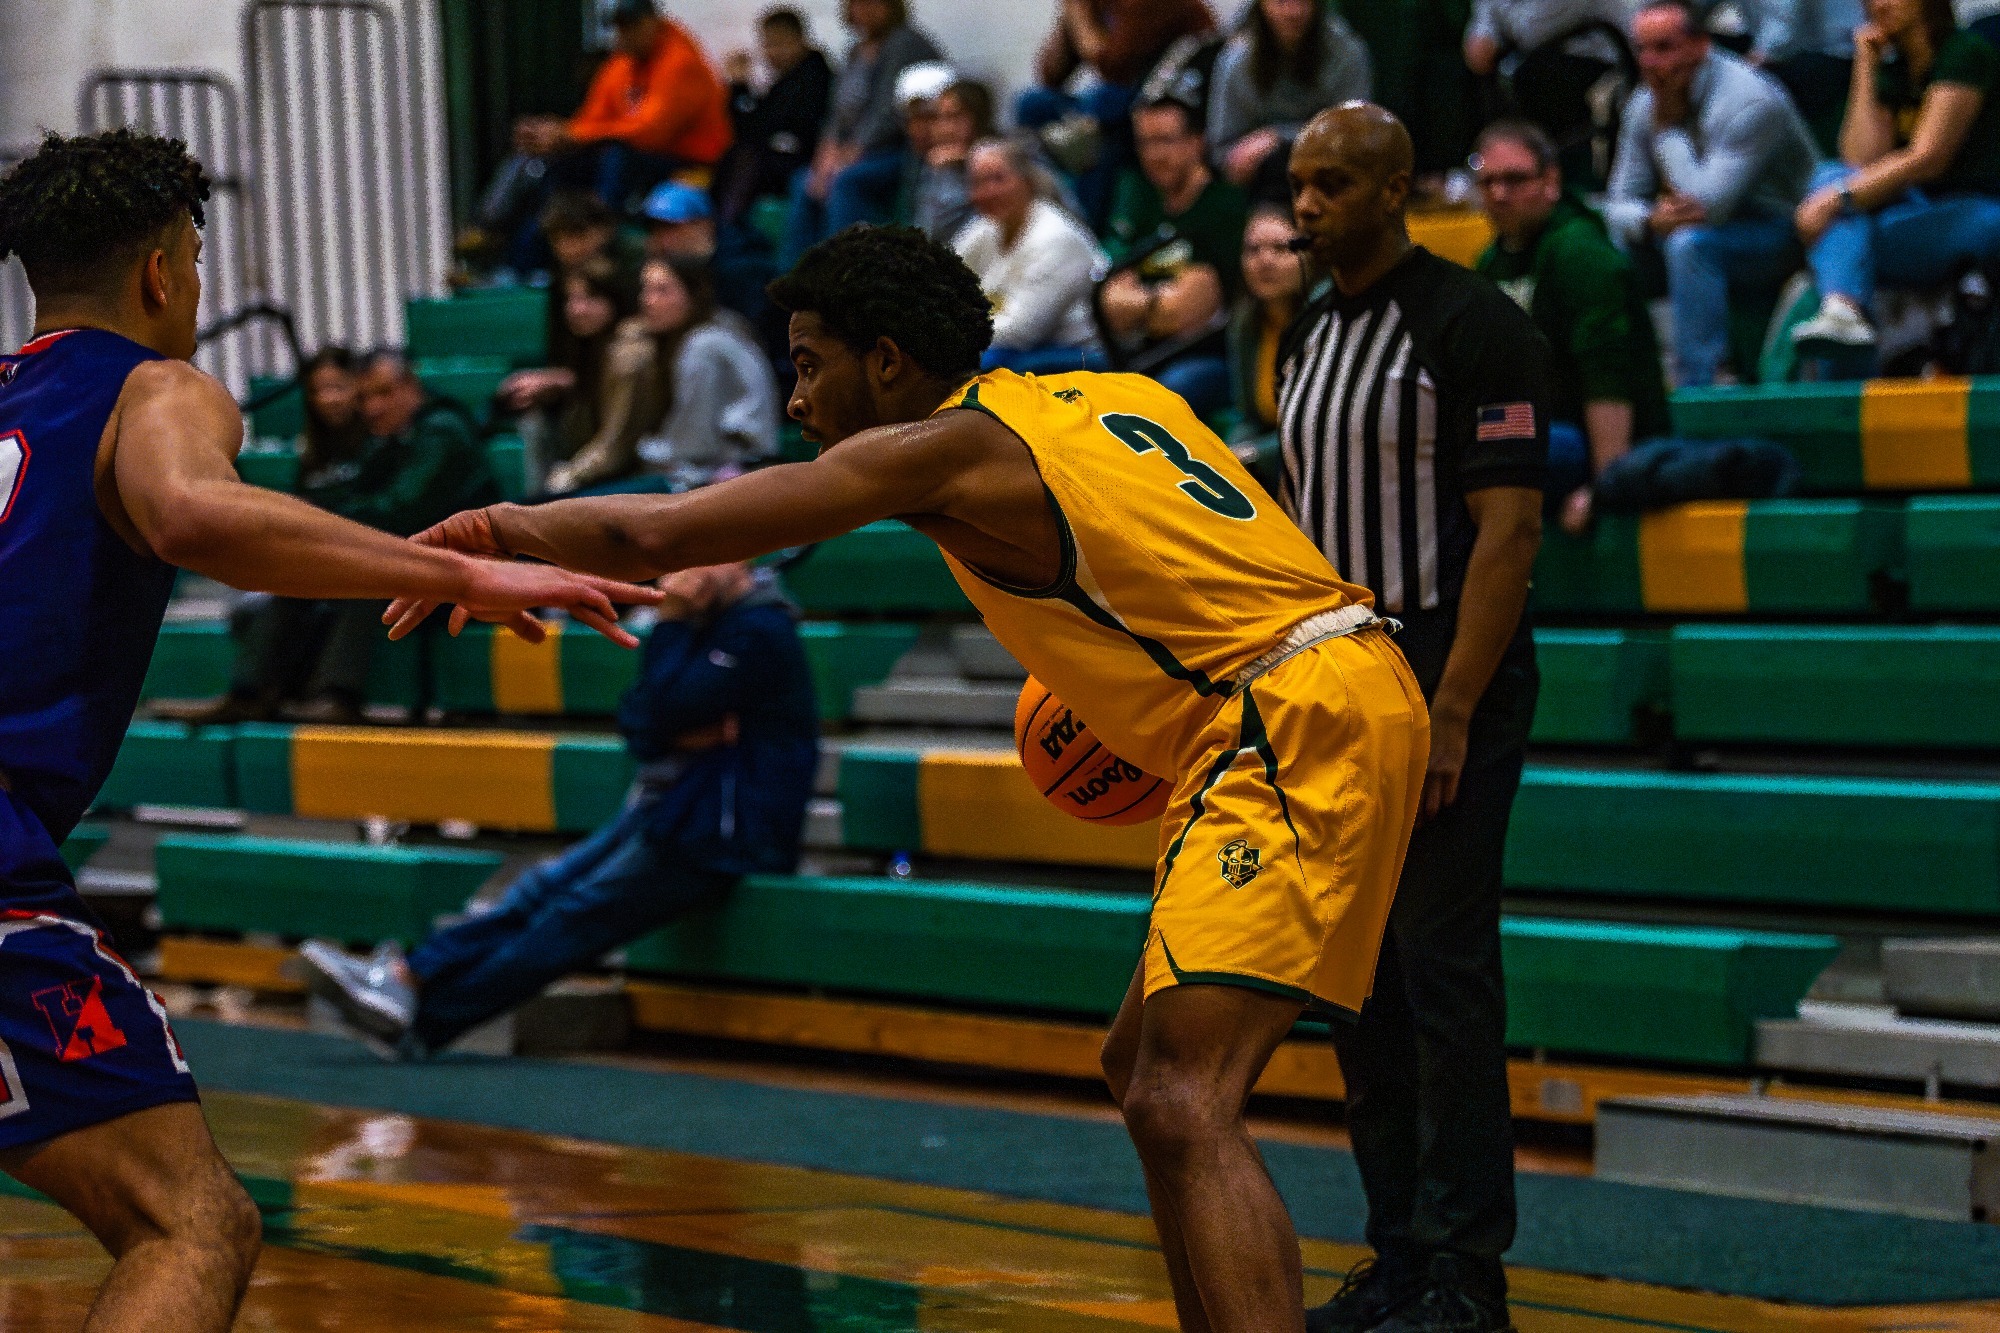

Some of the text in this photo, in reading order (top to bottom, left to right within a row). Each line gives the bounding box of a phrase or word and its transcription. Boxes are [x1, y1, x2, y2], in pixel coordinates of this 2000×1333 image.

[1098, 411, 1258, 522] 3
[1040, 709, 1087, 761] AA
[1067, 756, 1143, 806] lson
